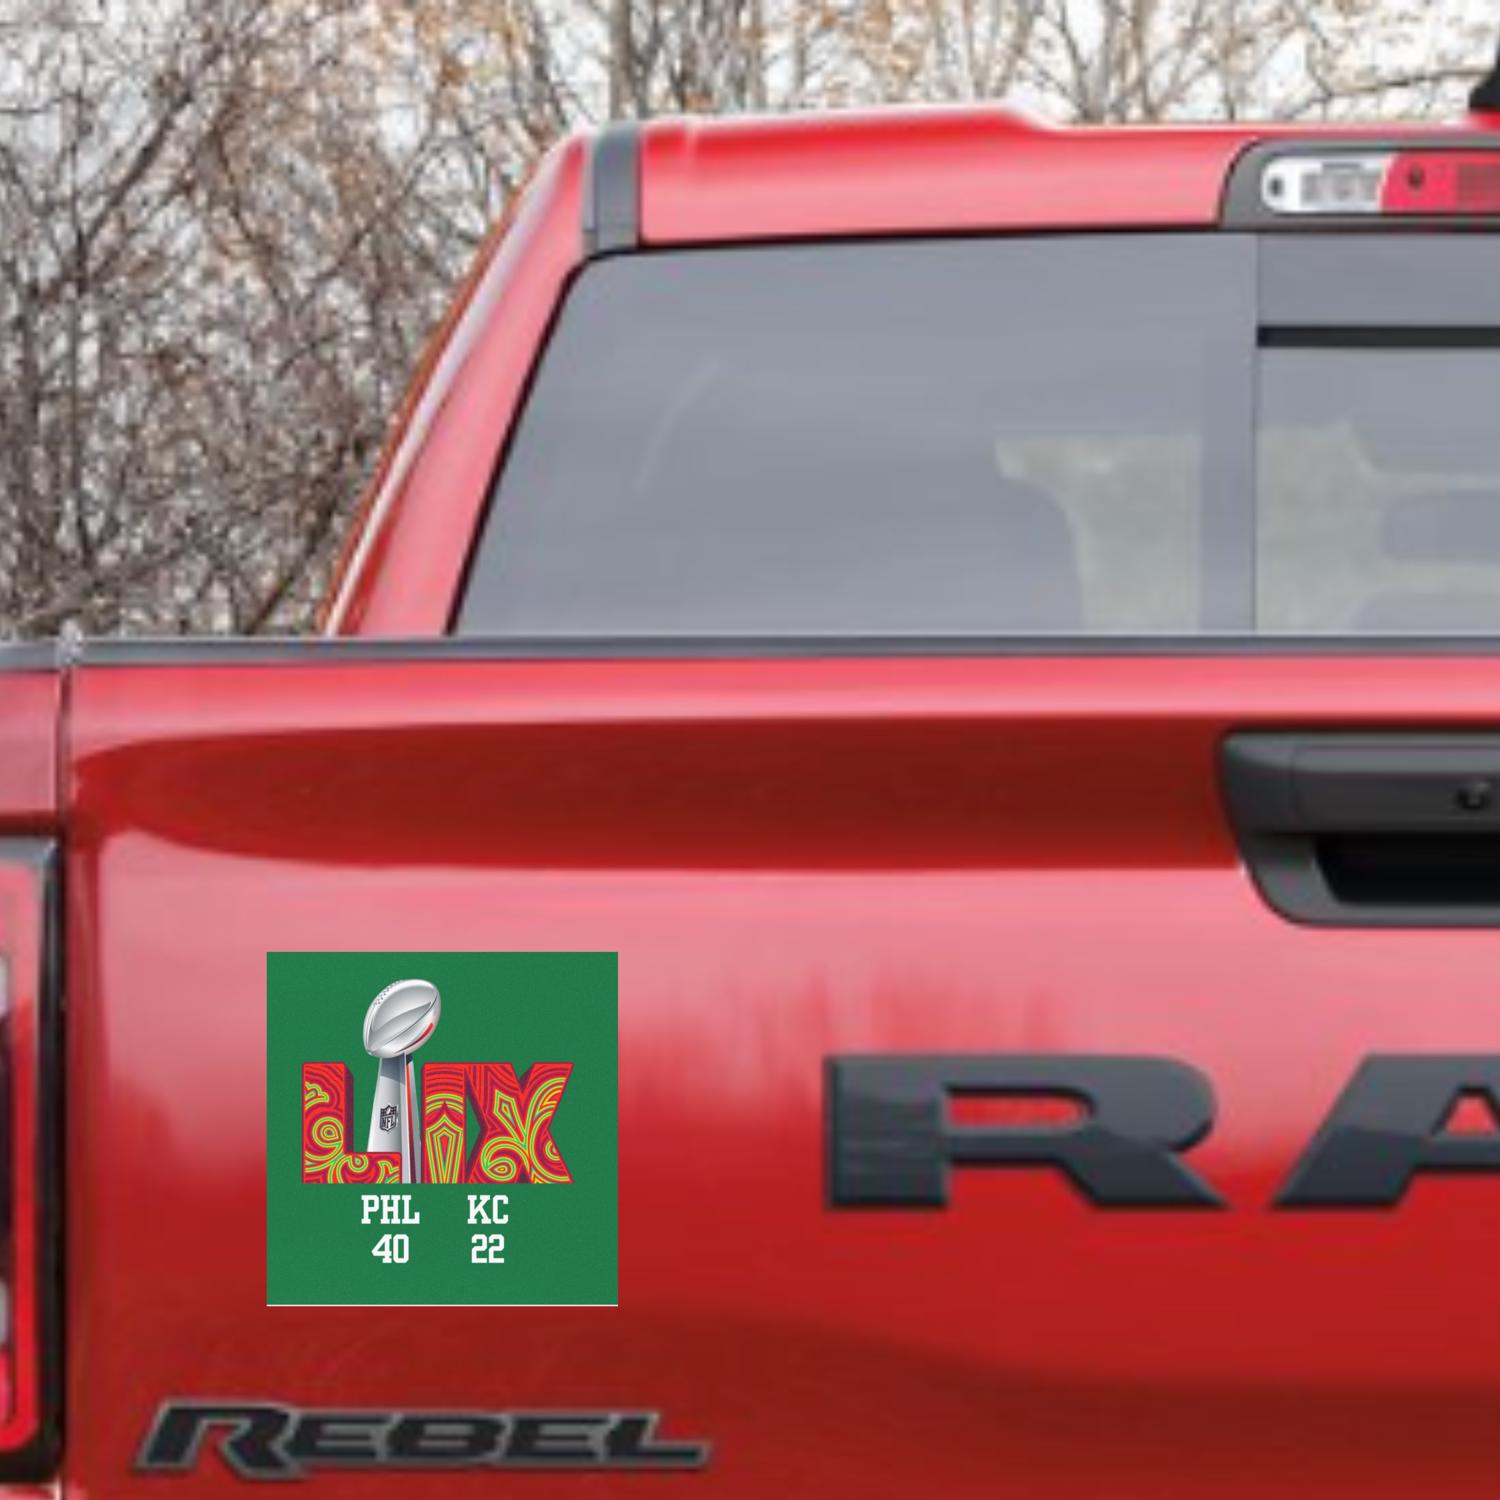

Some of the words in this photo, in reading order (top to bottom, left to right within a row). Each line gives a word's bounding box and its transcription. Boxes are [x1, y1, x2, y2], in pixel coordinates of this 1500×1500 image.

[302, 1062, 574, 1184] LIX
[361, 1195, 420, 1225] PHL
[467, 1195, 509, 1225] KC
[371, 1234, 410, 1264] 40
[471, 1234, 505, 1264] 22
[134, 1399, 712, 1481] REBEL
